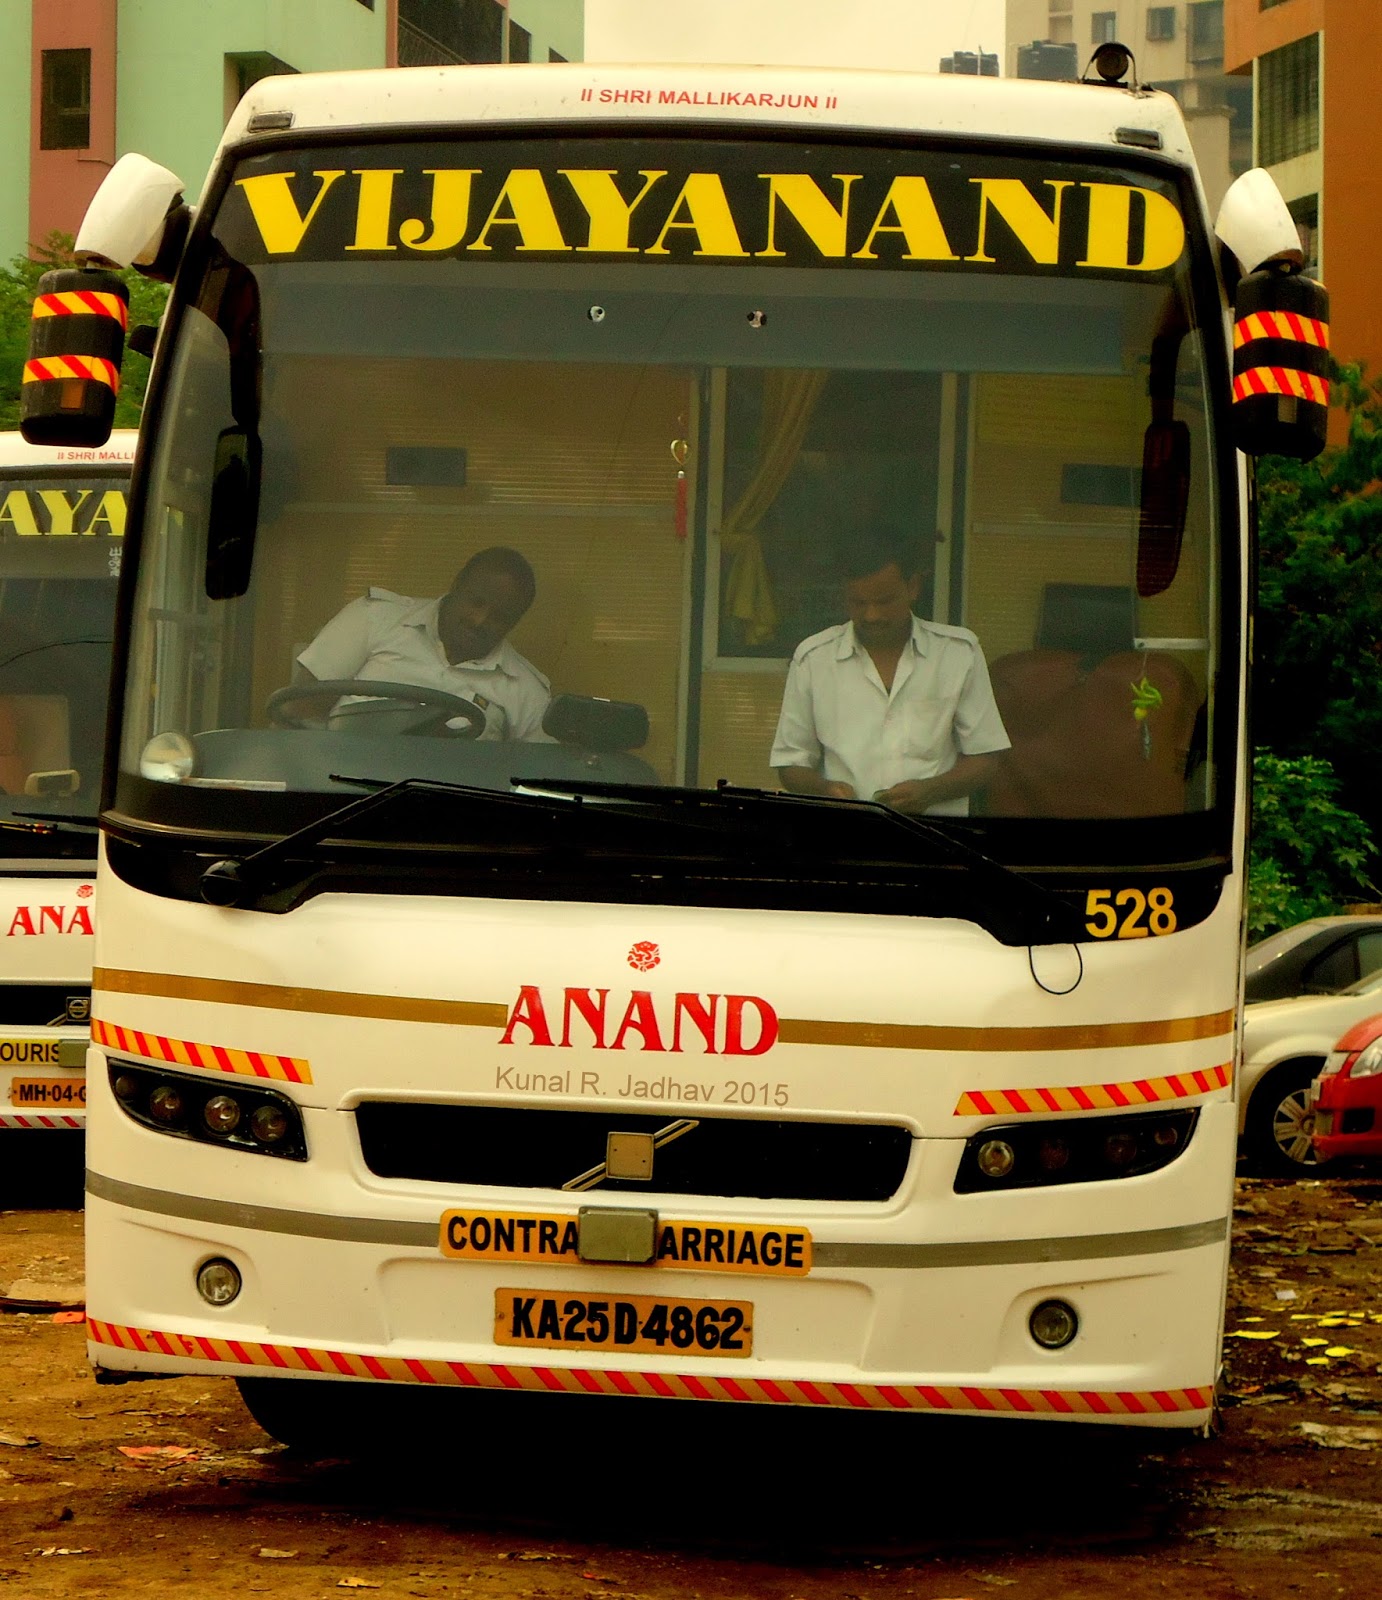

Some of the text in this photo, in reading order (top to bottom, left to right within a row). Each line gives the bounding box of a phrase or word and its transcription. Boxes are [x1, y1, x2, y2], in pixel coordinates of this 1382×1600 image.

[599, 89, 652, 104] SHRI
[658, 90, 819, 109] MALLIKARJUN
[235, 168, 1185, 272] VIJAYANAND
[67, 452, 95, 460] SHRI
[98, 451, 135, 460] MALLI
[0, 489, 128, 536] AYA
[7, 905, 95, 937] ANA
[1085, 887, 1177, 938] 528
[498, 985, 779, 1056] ANAND
[0, 1043, 59, 1063] OURIS
[447, 1216, 804, 1268] CONTRA ARRIAGE
